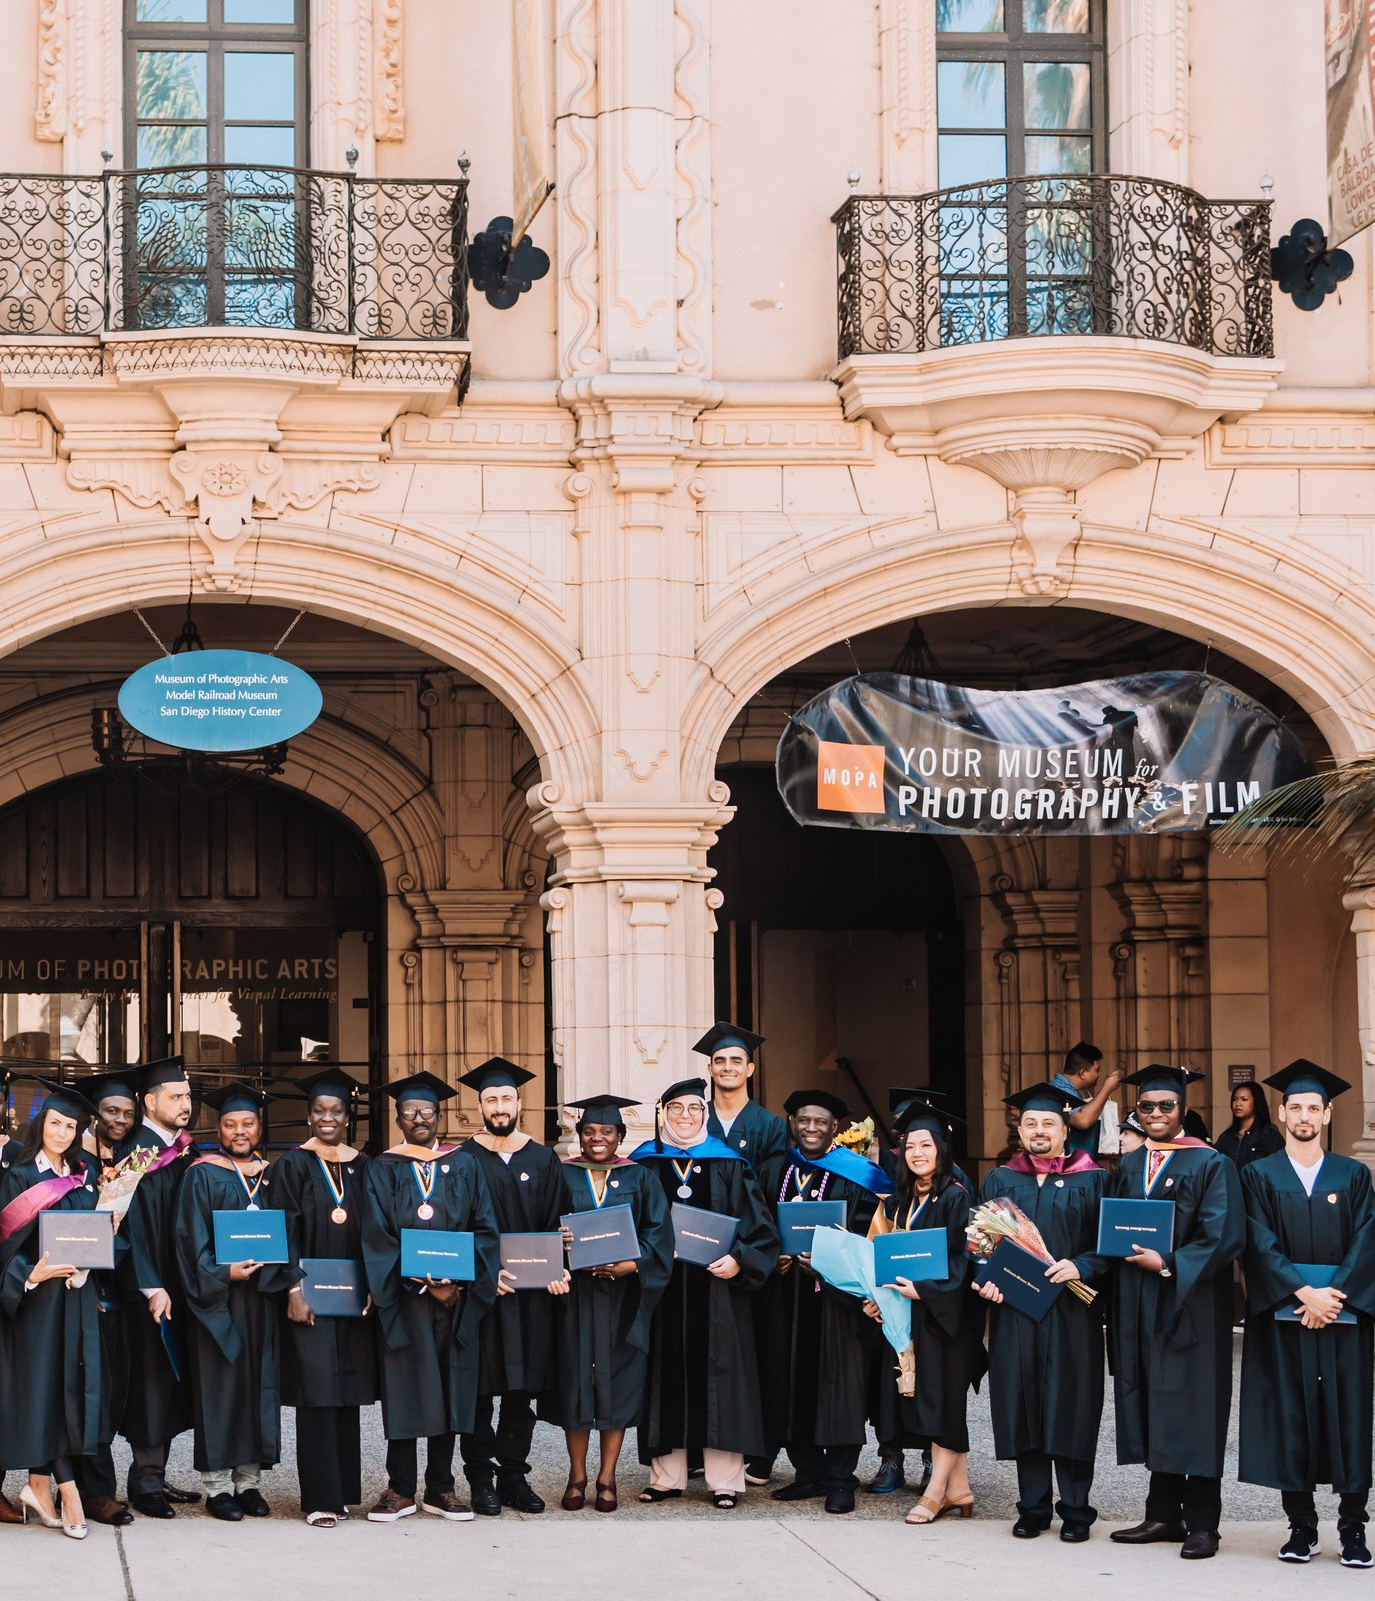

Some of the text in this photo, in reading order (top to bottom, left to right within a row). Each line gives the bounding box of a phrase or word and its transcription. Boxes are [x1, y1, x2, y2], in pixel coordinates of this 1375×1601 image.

[1361, 142, 1375, 162] DE
[1353, 202, 1375, 229] LEVE
[155, 673, 289, 687] Museum of Photographic Arts
[166, 689, 278, 700] Model Railroad Museum
[160, 706, 178, 717] San
[181, 706, 210, 719] Diego
[212, 706, 246, 719] History
[249, 706, 281, 717] Center
[898, 747, 1159, 779] YOUR MUSEUM for
[823, 768, 877, 788] MOPA
[898, 780, 1262, 820] PHOTOGRAPHY & FILM
[36, 959, 66, 980] OF
[277, 958, 338, 980] ARTS
[237, 987, 276, 1000] Visual
[280, 987, 337, 1003] Learning
